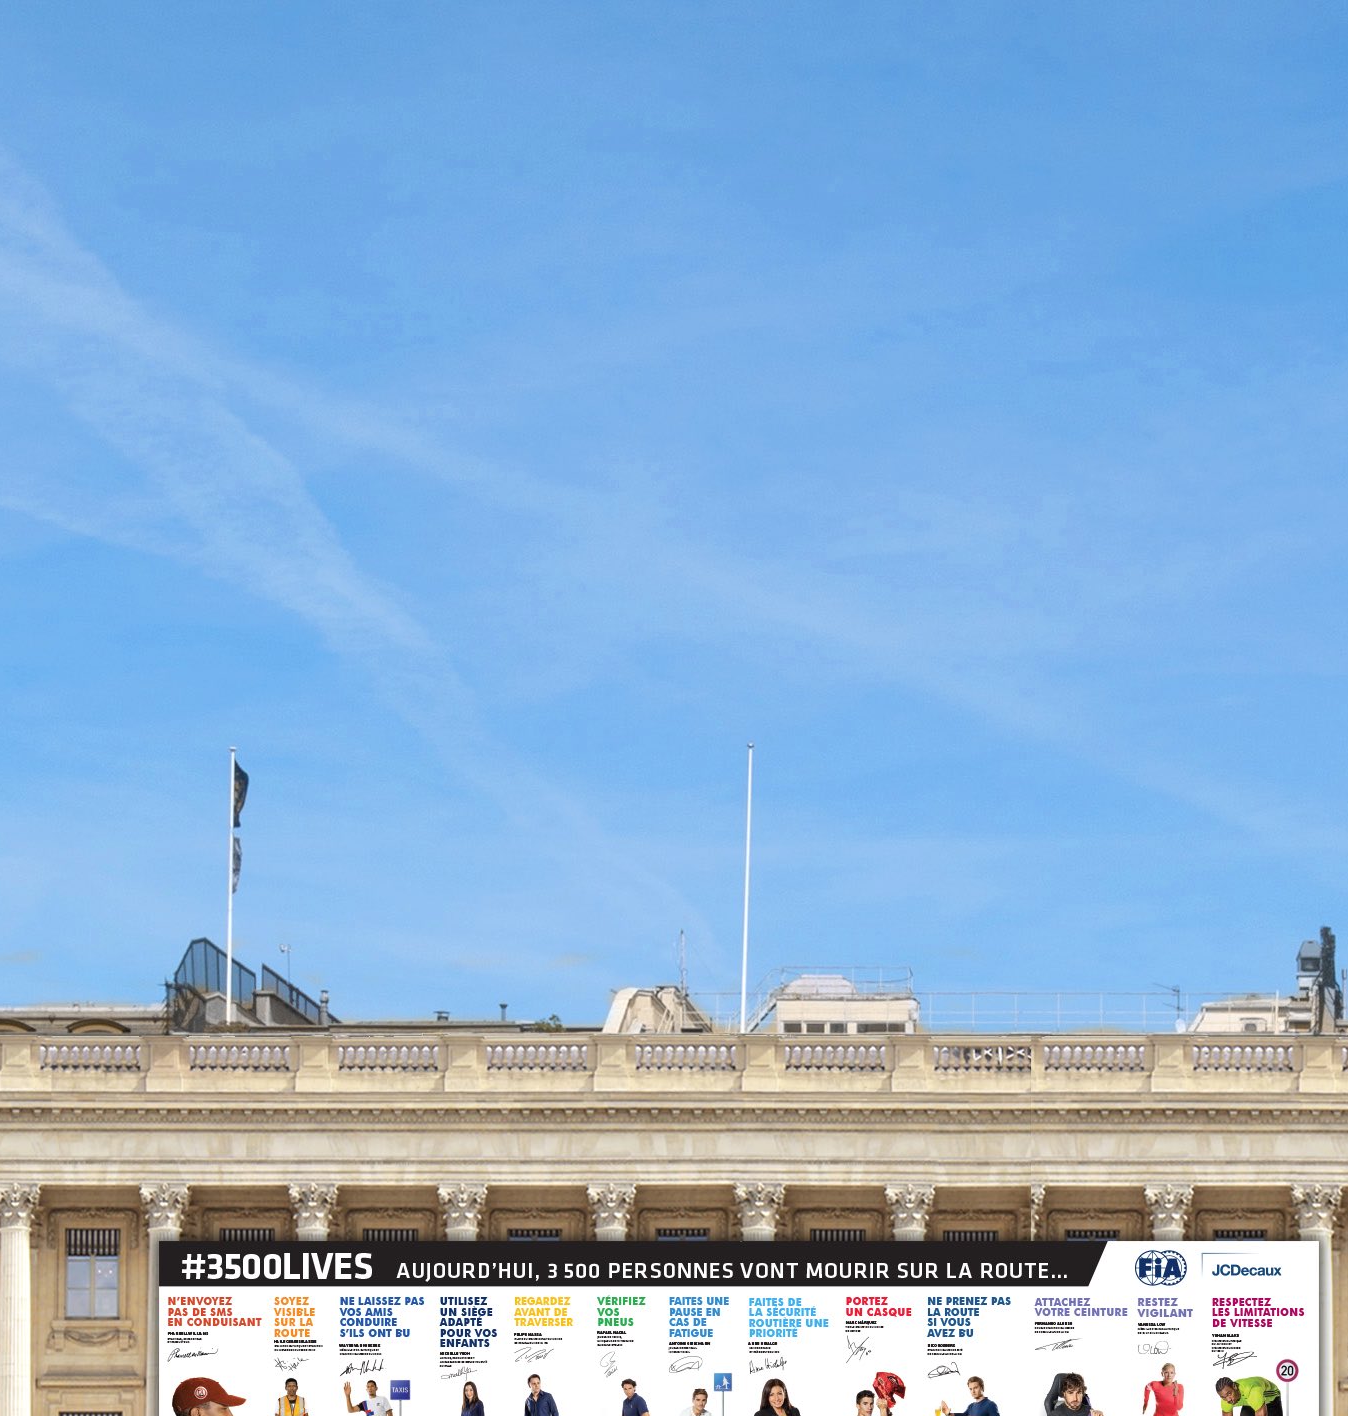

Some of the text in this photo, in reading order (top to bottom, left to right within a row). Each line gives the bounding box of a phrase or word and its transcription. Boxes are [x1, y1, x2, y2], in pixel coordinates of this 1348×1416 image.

[182, 1253, 372, 1279] #3500LIVES
[1212, 1264, 1281, 1276] JCDecaux
[397, 1263, 539, 1282] AUJOURD'HUI,
[609, 1263, 733, 1278] PERSONNES
[740, 1263, 798, 1278] VONT
[807, 1263, 889, 1278] MOURIR
[898, 1263, 938, 1278] SUR
[947, 1263, 972, 1278] LA
[168, 1297, 232, 1305] N'ENVOYEZ
[275, 1297, 309, 1305] SOYEZ
[340, 1297, 424, 1305] NE LAISSEZ PAS
[440, 1297, 487, 1305] UTILISEZ
[515, 1297, 570, 1305] REGARDEZ
[597, 1295, 646, 1305] VÉRIFIEZ
[669, 1297, 729, 1305] FAITES UNE
[749, 1298, 801, 1306] FAITES DE
[846, 1297, 888, 1305] PORTEZ
[928, 1297, 1011, 1305] NE PRENEZ PAS
[1035, 1298, 1090, 1306] ATTACHEZ
[1138, 1298, 1178, 1306] RESTEZ
[1212, 1298, 1271, 1306] RESPECTEZ
[168, 1308, 232, 1316] PAS DE SMS
[274, 1308, 315, 1316] VISIBLE
[340, 1308, 392, 1316] VOS AMIS
[440, 1306, 492, 1316] UN SIÈGE
[514, 1308, 567, 1316] AVANT DE
[597, 1308, 619, 1316] VOS
[670, 1308, 720, 1316] PAUSE EN
[749, 1306, 816, 1316] LA SÉCURITÉ
[846, 1308, 911, 1317] UN CASQUE
[928, 1308, 979, 1316] LA ROUTE
[1035, 1308, 1127, 1316] VOTRE CEINTURE
[1138, 1309, 1193, 1317] VIGILANT
[1212, 1308, 1304, 1316] LES LIMITATIONS
[168, 1318, 262, 1326] EN CONDUISANT
[275, 1318, 313, 1326] SUR LA
[340, 1318, 397, 1326] CONDUIRE
[440, 1316, 482, 1326] ADAPTÉ
[514, 1318, 573, 1326] TRAVERSER
[598, 1318, 633, 1326] PNEUS
[669, 1318, 706, 1326] CAS DE
[749, 1317, 828, 1327] ROUTIÈRE UNE
[928, 1318, 971, 1326] SI VOUS
[1213, 1319, 1272, 1327] DE VITESSE
[275, 1329, 310, 1337] ROUTE
[340, 1329, 410, 1337] S'ILS ONT BU
[441, 1329, 497, 1337] POUR VOS
[669, 1329, 713, 1337] FATIGUE
[750, 1327, 797, 1337] PRIORITÉ
[927, 1329, 973, 1337] AVEZ BU
[440, 1339, 490, 1347] ENFANTS
[1281, 1366, 1294, 1376] 20
